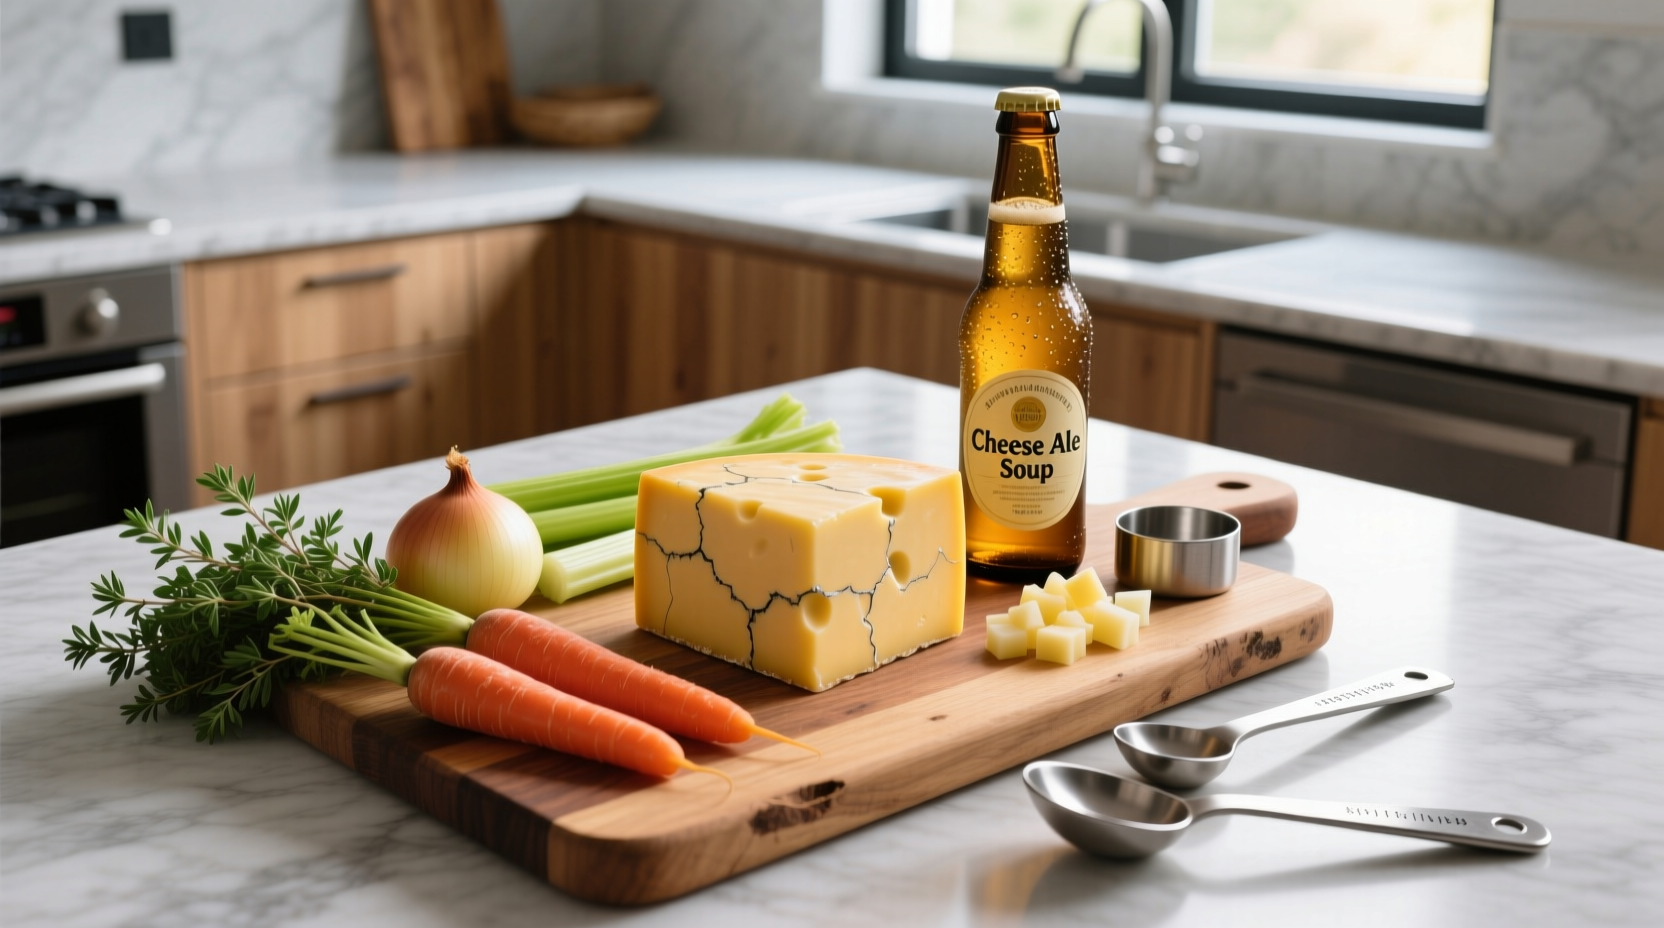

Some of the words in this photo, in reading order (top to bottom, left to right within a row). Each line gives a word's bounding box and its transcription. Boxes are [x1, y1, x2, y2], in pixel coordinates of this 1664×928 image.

[971, 428, 1045, 456] Cheese
[1049, 429, 1081, 455] Ale
[1000, 458, 1054, 484] Soup
